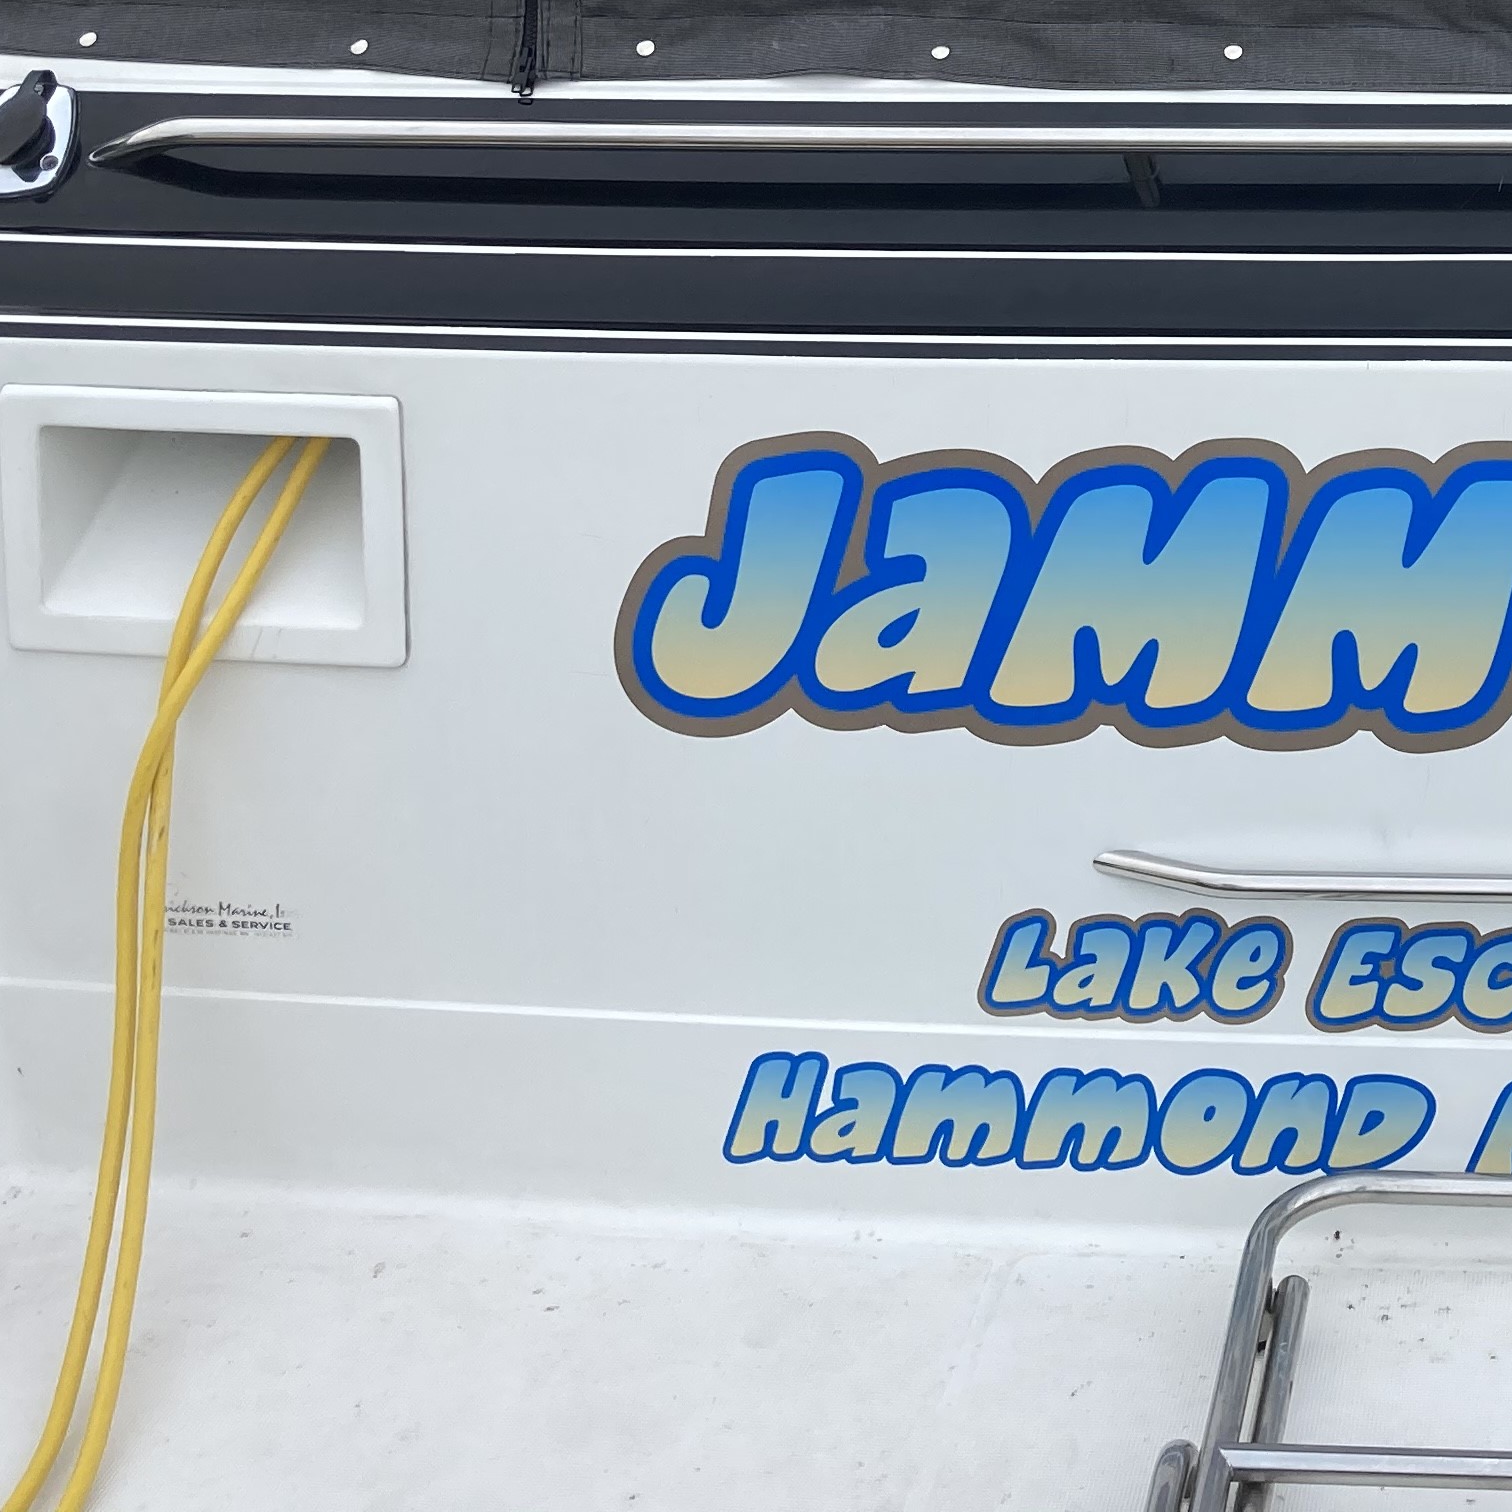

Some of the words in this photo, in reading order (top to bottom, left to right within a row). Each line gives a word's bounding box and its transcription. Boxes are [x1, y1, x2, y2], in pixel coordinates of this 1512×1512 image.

[168, 917, 214, 928] SALES
[218, 919, 228, 928] &
[231, 920, 293, 931] SERVICE
